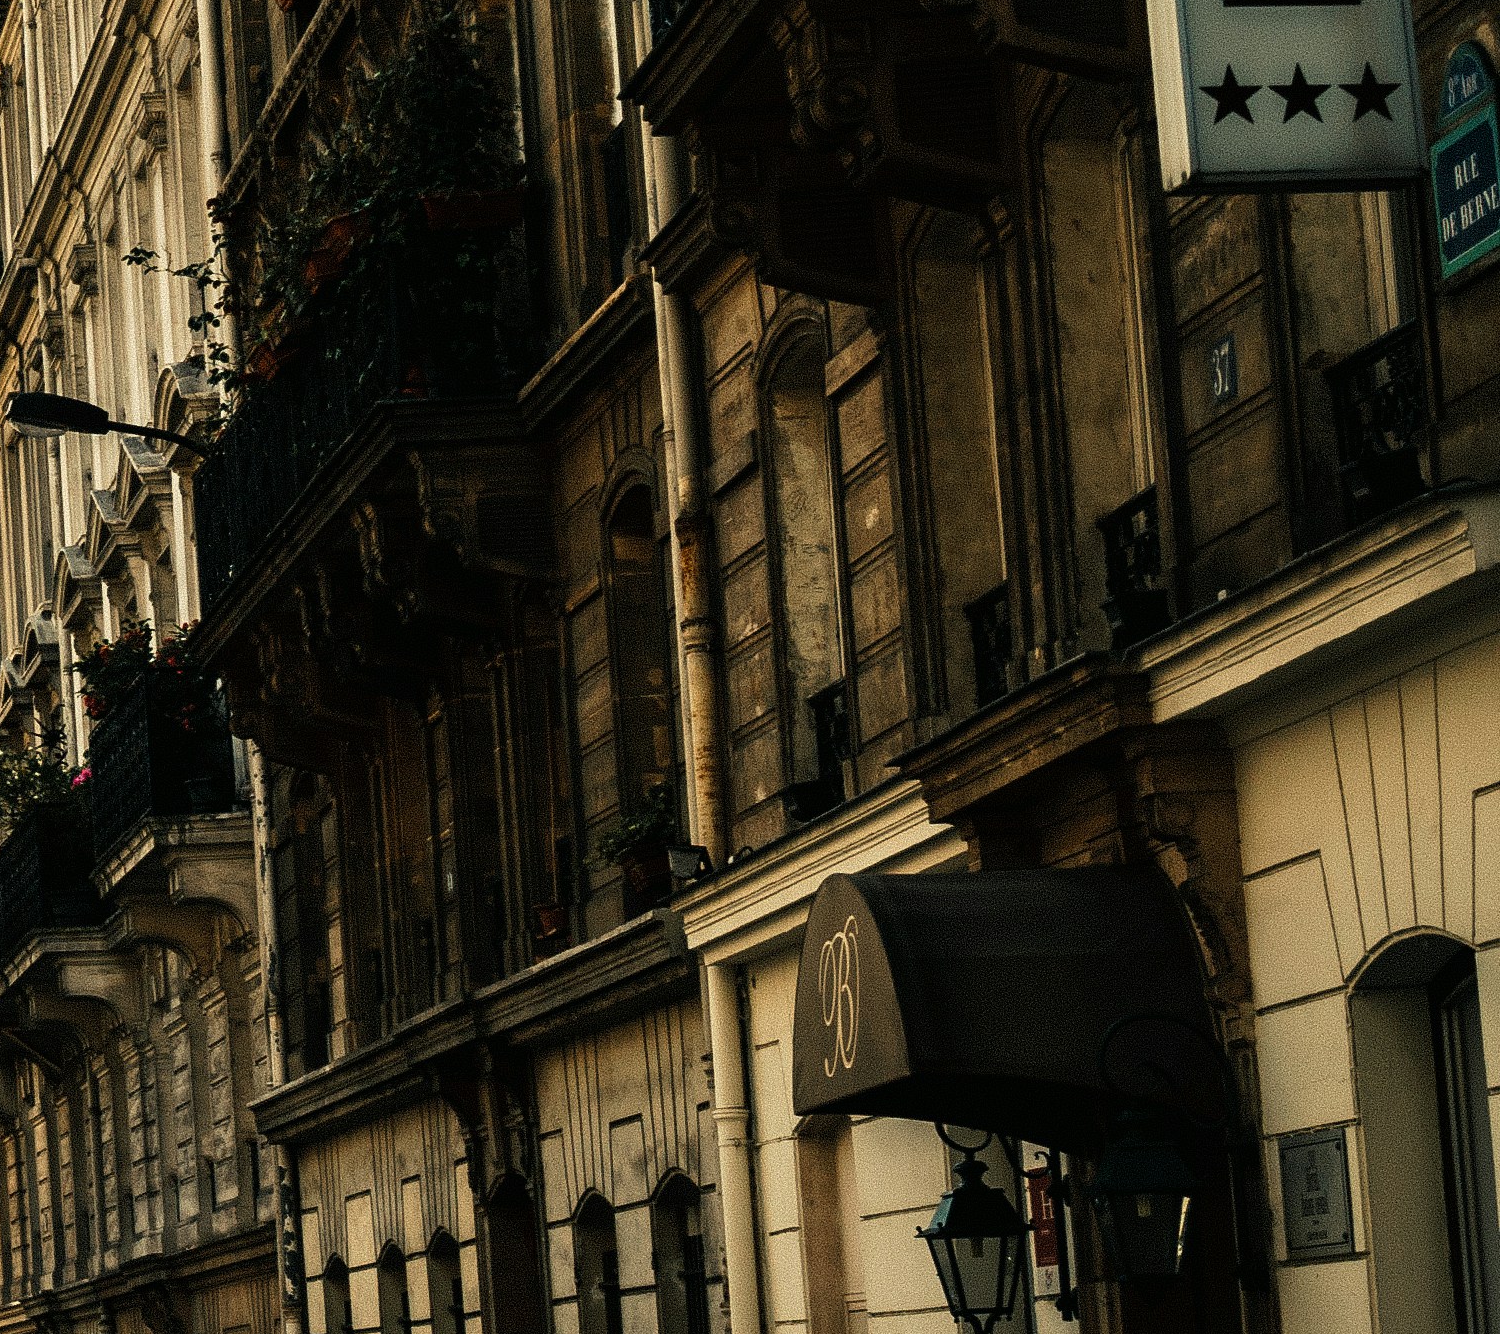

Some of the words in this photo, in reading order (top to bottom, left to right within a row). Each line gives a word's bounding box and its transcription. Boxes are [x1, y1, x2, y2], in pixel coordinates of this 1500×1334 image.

[1454, 152, 1479, 190] RUE
[1441, 211, 1458, 242] DE
[1460, 183, 1500, 231] BERNE
